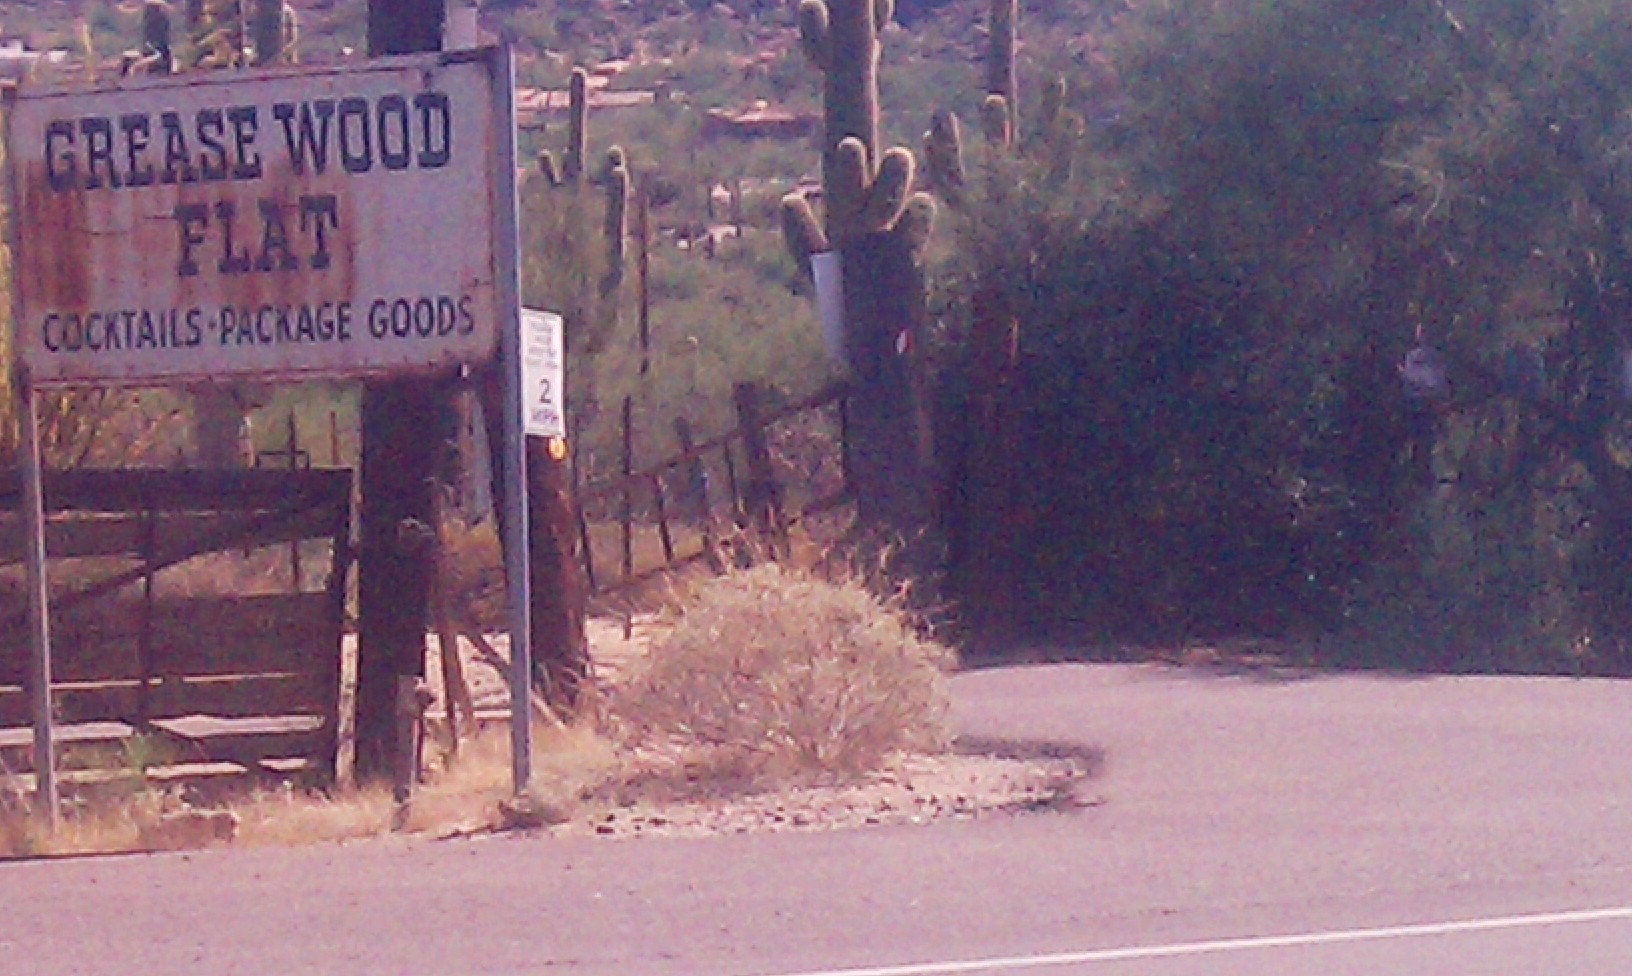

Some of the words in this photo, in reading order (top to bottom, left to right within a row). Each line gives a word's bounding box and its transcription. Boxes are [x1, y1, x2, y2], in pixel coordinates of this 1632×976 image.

[174, 194, 339, 277] FLAT
[368, 294, 474, 338] GOODS
[539, 377, 552, 404] 2
